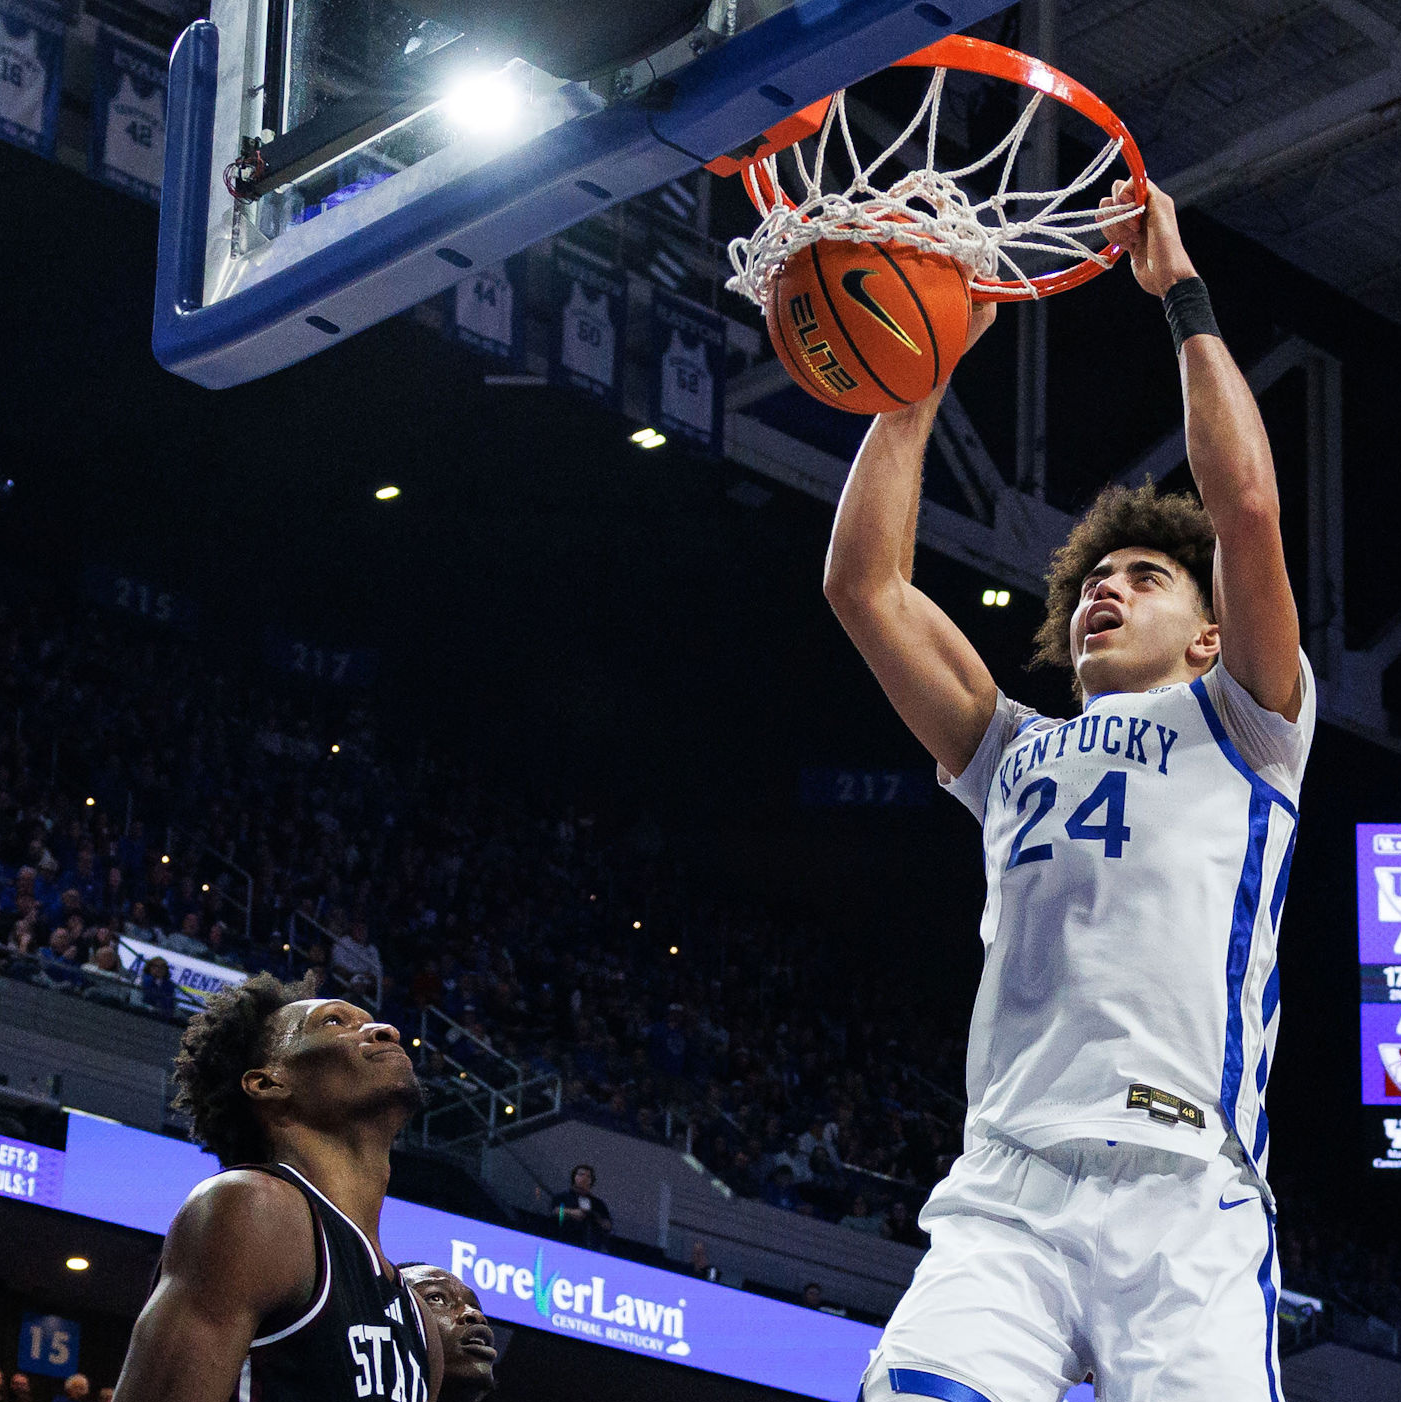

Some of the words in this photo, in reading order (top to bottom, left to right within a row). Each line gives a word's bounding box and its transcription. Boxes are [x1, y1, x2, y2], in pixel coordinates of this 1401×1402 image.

[999, 714, 1178, 808] KENTUCKY
[1005, 770, 1131, 871] 24
[179, 968, 225, 994] RENTA
[1181, 1107, 1195, 1119] 48
[30, 1325, 70, 1365] 15
[552, 1313, 604, 1338] CENTRAL
[605, 1326, 665, 1353] KENTUCKY
